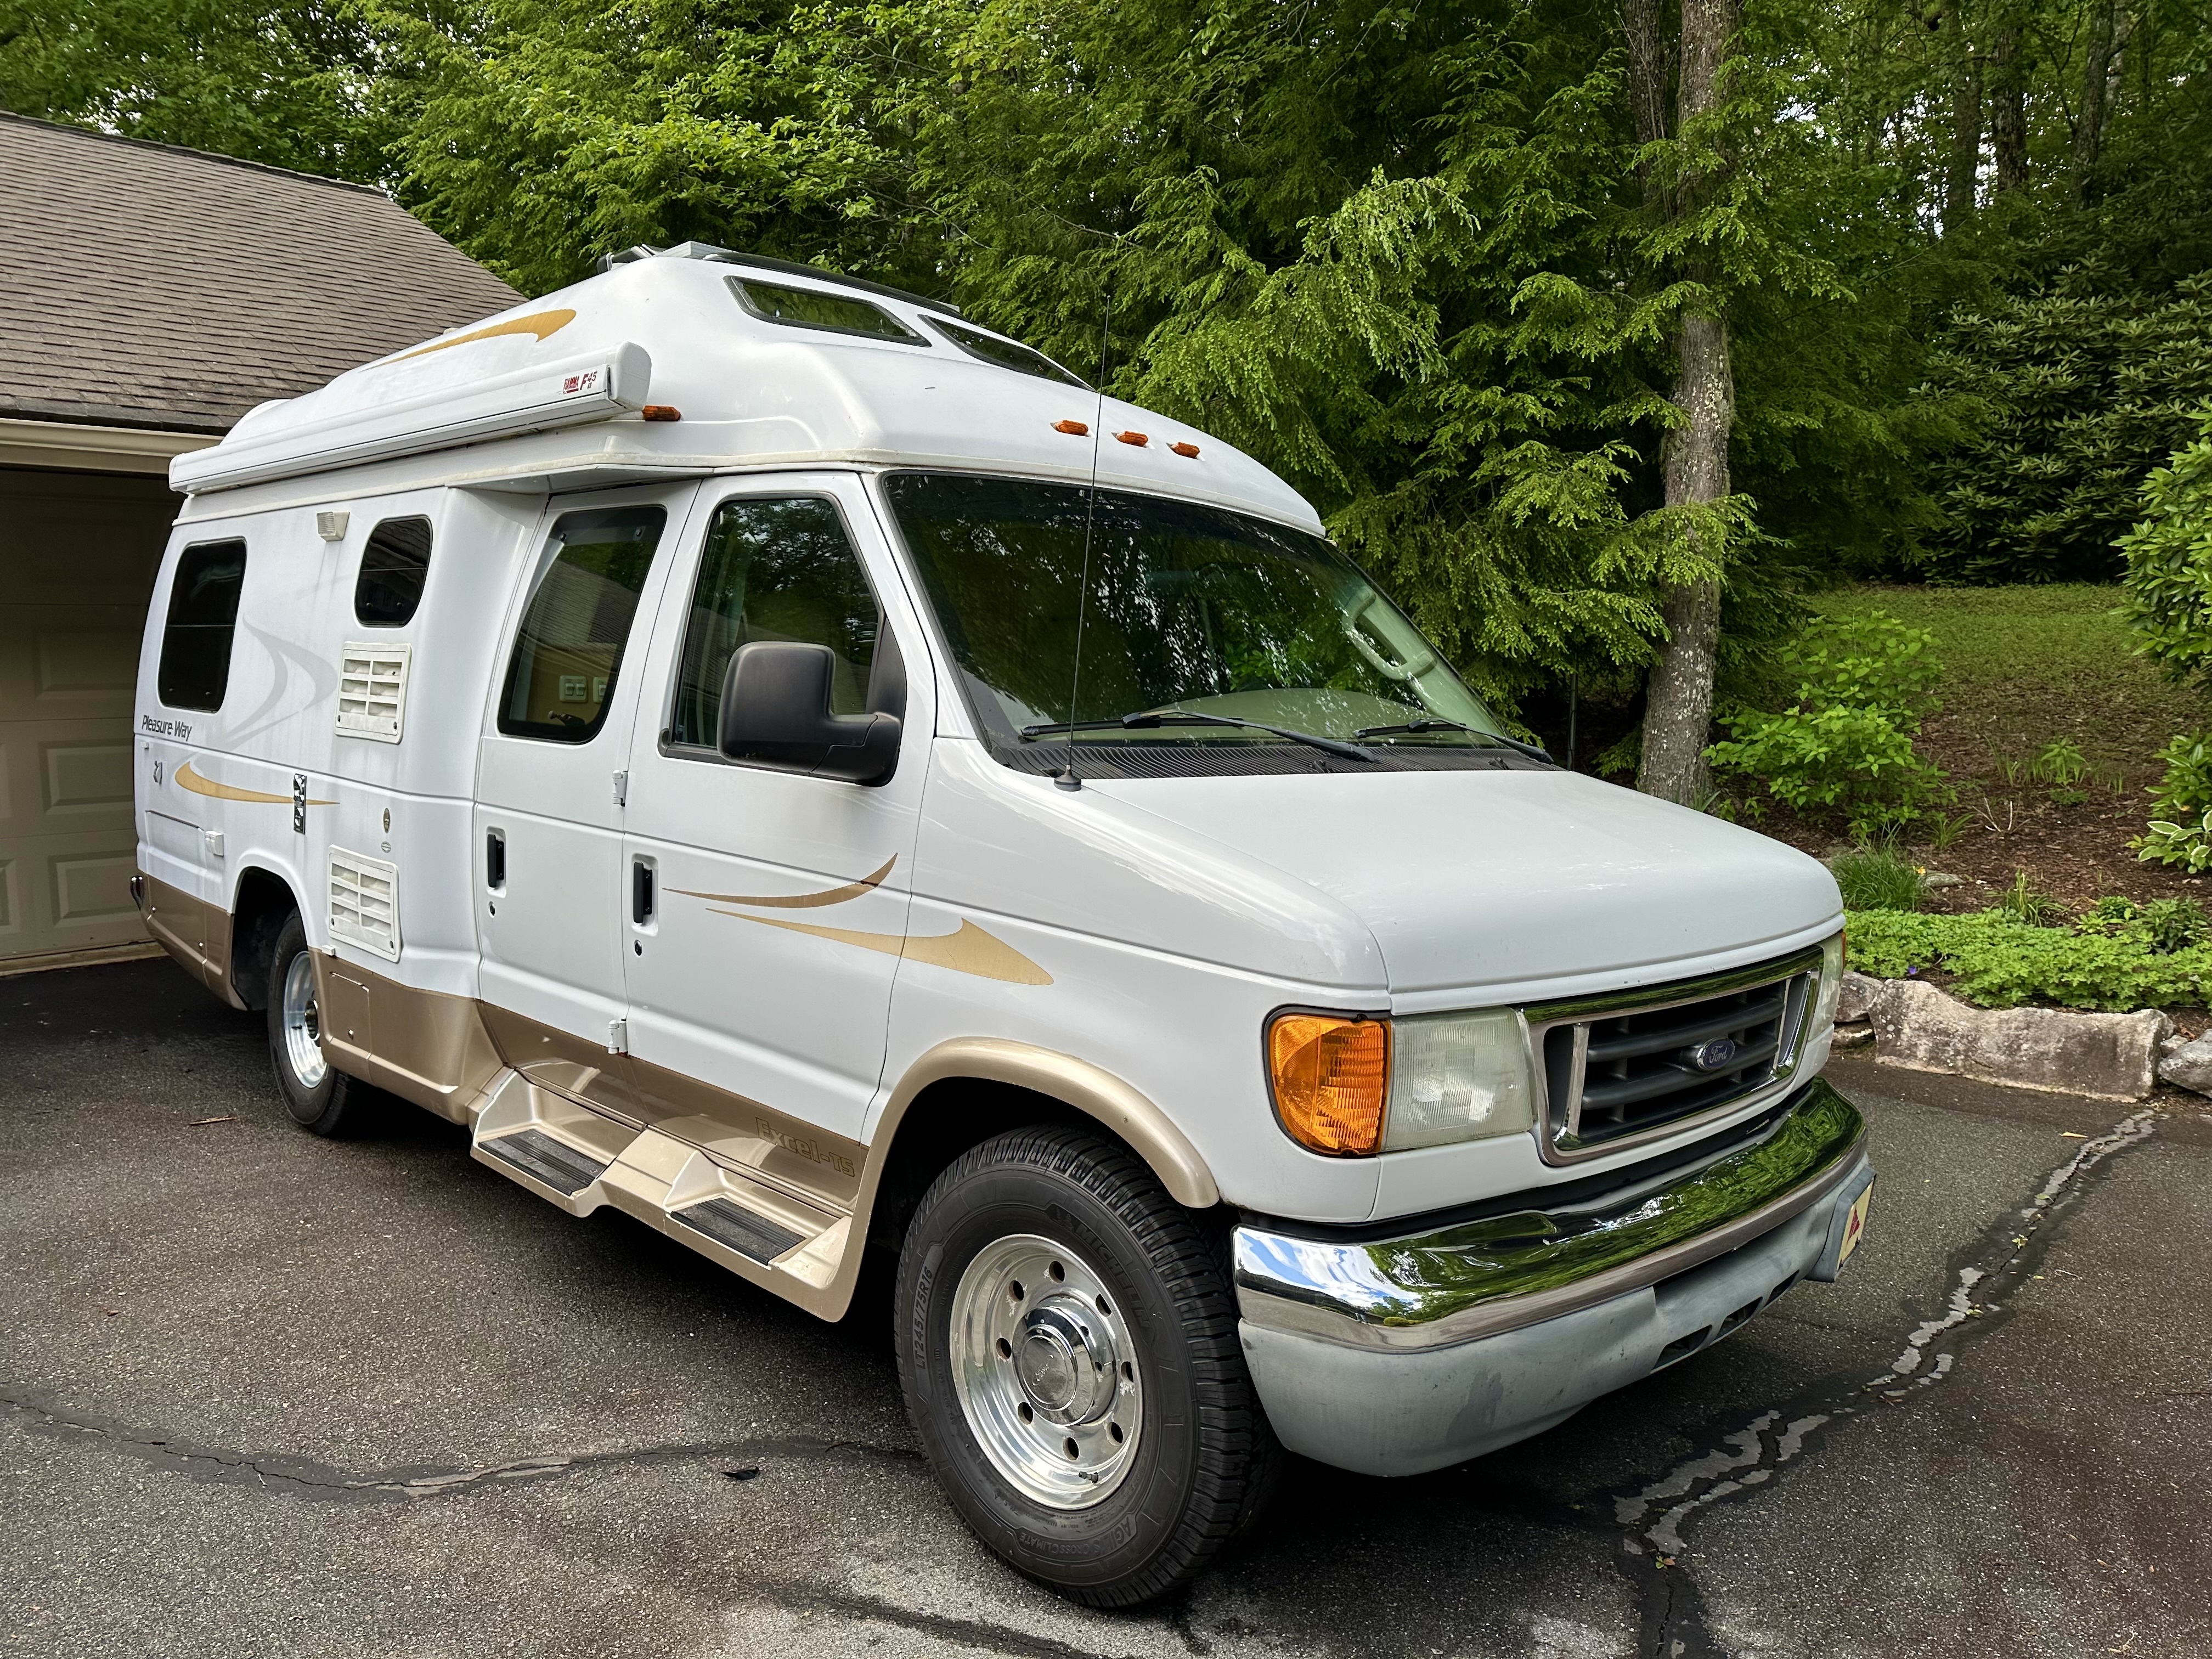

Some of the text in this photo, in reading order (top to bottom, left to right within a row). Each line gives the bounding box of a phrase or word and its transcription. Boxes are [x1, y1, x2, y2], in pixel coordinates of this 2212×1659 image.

[1709, 1046, 1728, 1063] Ford
[755, 1117, 855, 1177] Excel-TS
[1076, 1223, 1151, 1330] MICHELIN
[915, 1266, 933, 1369] LT245/75R16
[1019, 1532, 1090, 1554] CROSSCLIMATE
[1094, 1516, 1132, 1553] AGILS
